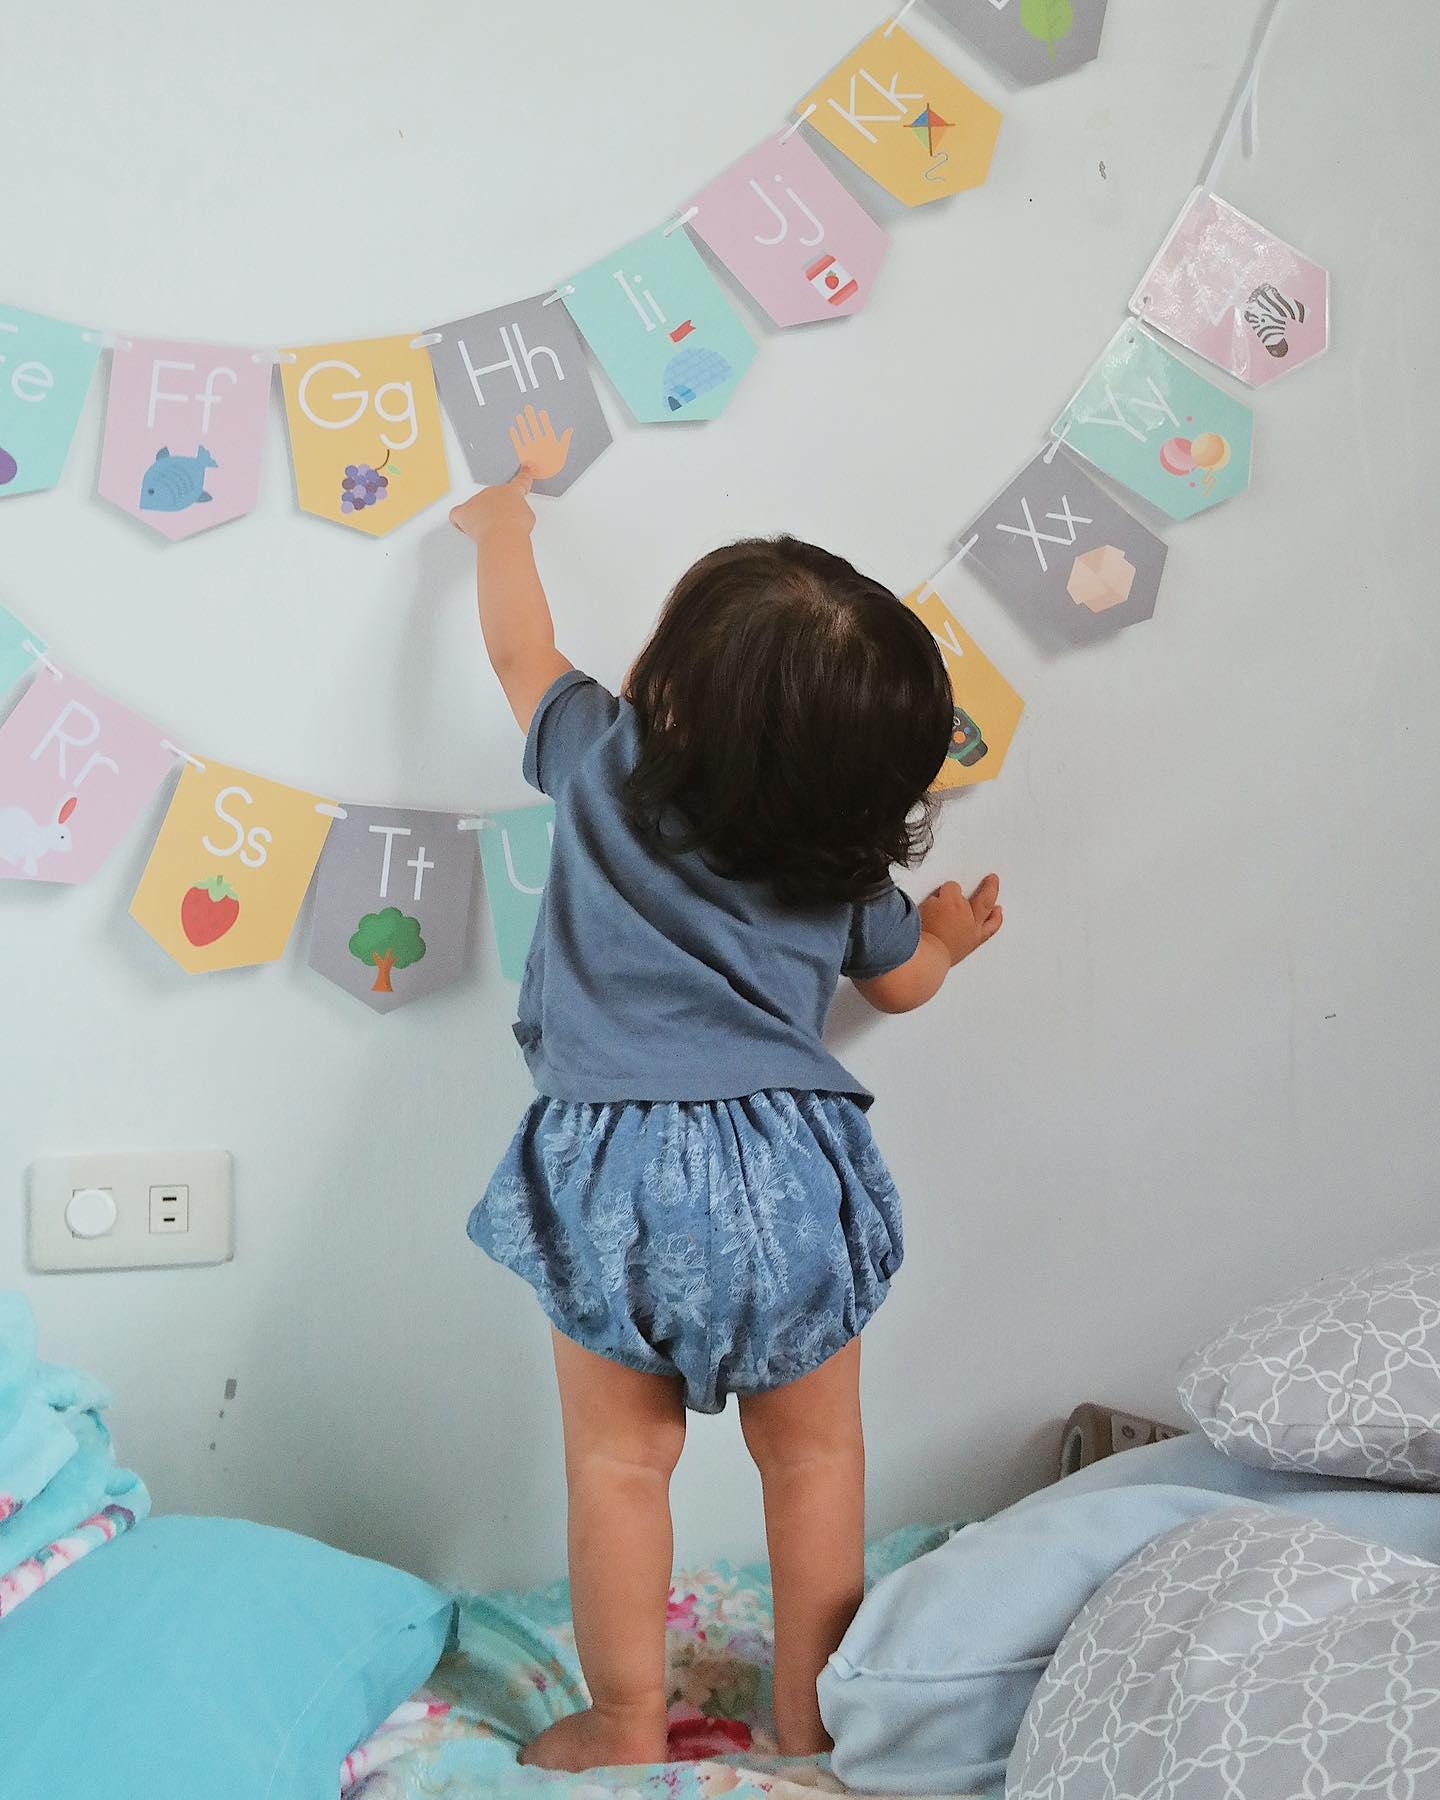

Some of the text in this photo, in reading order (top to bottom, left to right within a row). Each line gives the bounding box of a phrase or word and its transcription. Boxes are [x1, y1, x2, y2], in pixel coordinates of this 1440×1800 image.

[827, 68, 924, 144] Kk
[749, 174, 824, 246] Jj
[147, 359, 238, 433] Ff
[457, 322, 565, 406] Hh
[298, 360, 419, 450] Gg
[1076, 375, 1180, 443] Yy
[995, 495, 1093, 572] Xx
[29, 699, 119, 787] Rr
[202, 786, 272, 868] Ss
[369, 824, 434, 900] Tt
